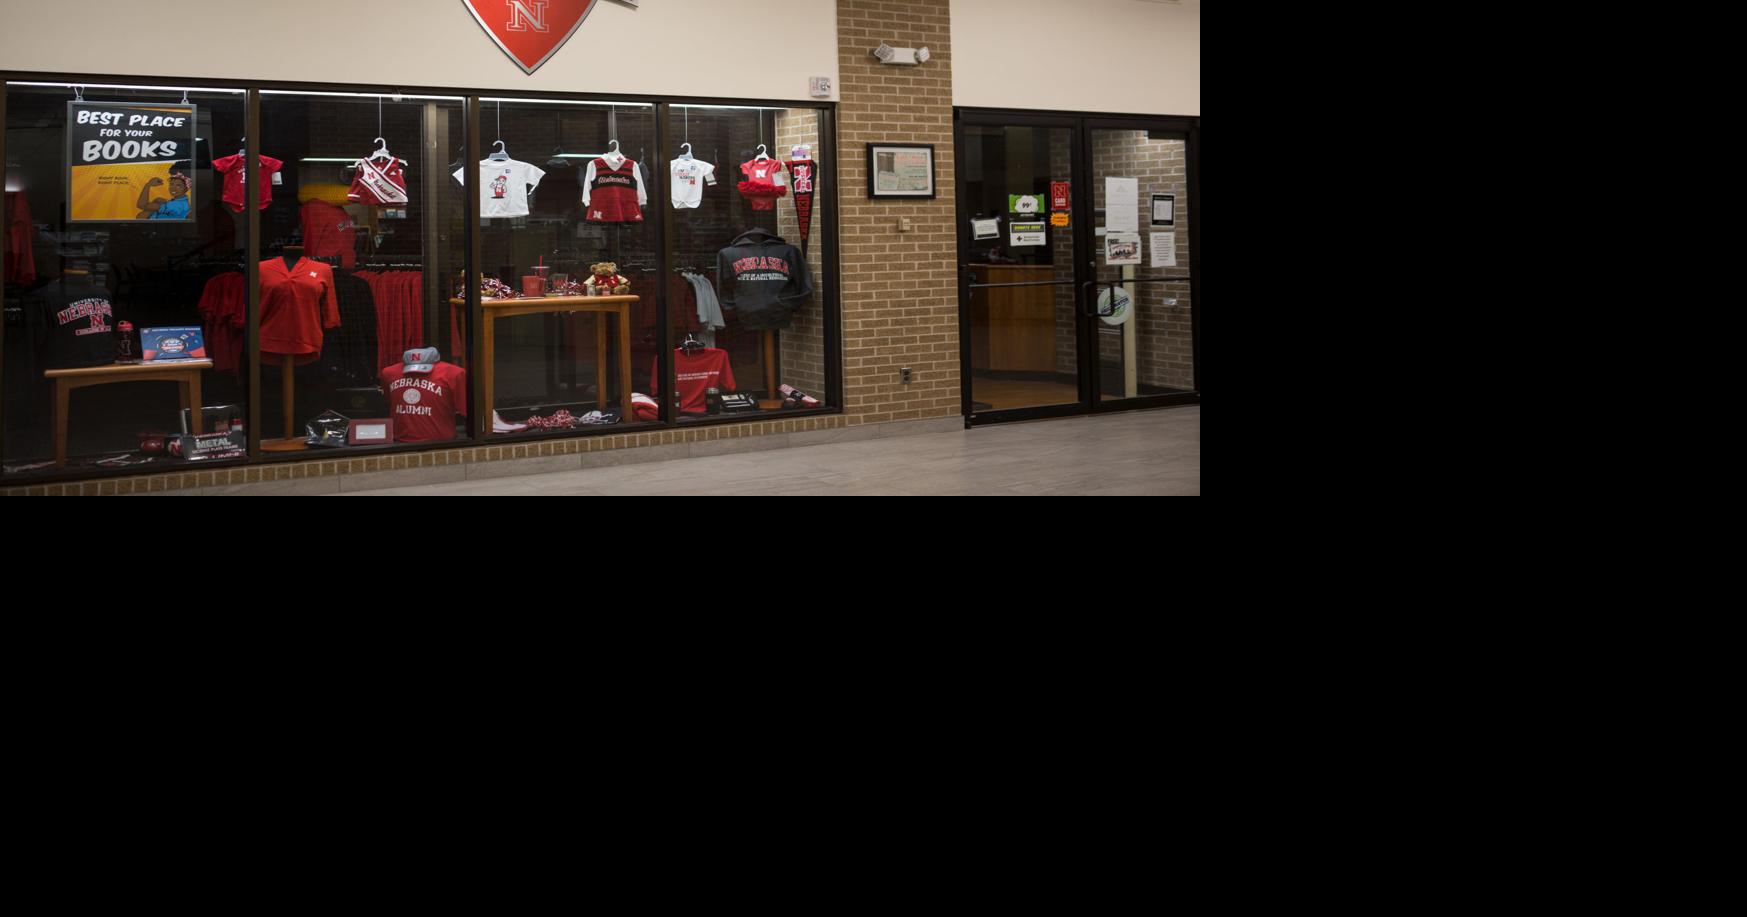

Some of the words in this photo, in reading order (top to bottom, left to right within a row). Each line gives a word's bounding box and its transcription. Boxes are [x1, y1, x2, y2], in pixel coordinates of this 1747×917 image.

[506, 0, 550, 33] N
[77, 110, 124, 126] BEST
[128, 114, 186, 128] PLACE
[100, 128, 121, 137] FOR
[124, 129, 153, 137] YOUR
[82, 139, 178, 162] BOOKS
[755, 169, 766, 178] N
[90, 314, 105, 329] N
[411, 353, 422, 361] N
[389, 377, 443, 396] NEBRASKA
[396, 404, 432, 416] ALUMNI
[195, 437, 232, 449] METAL
